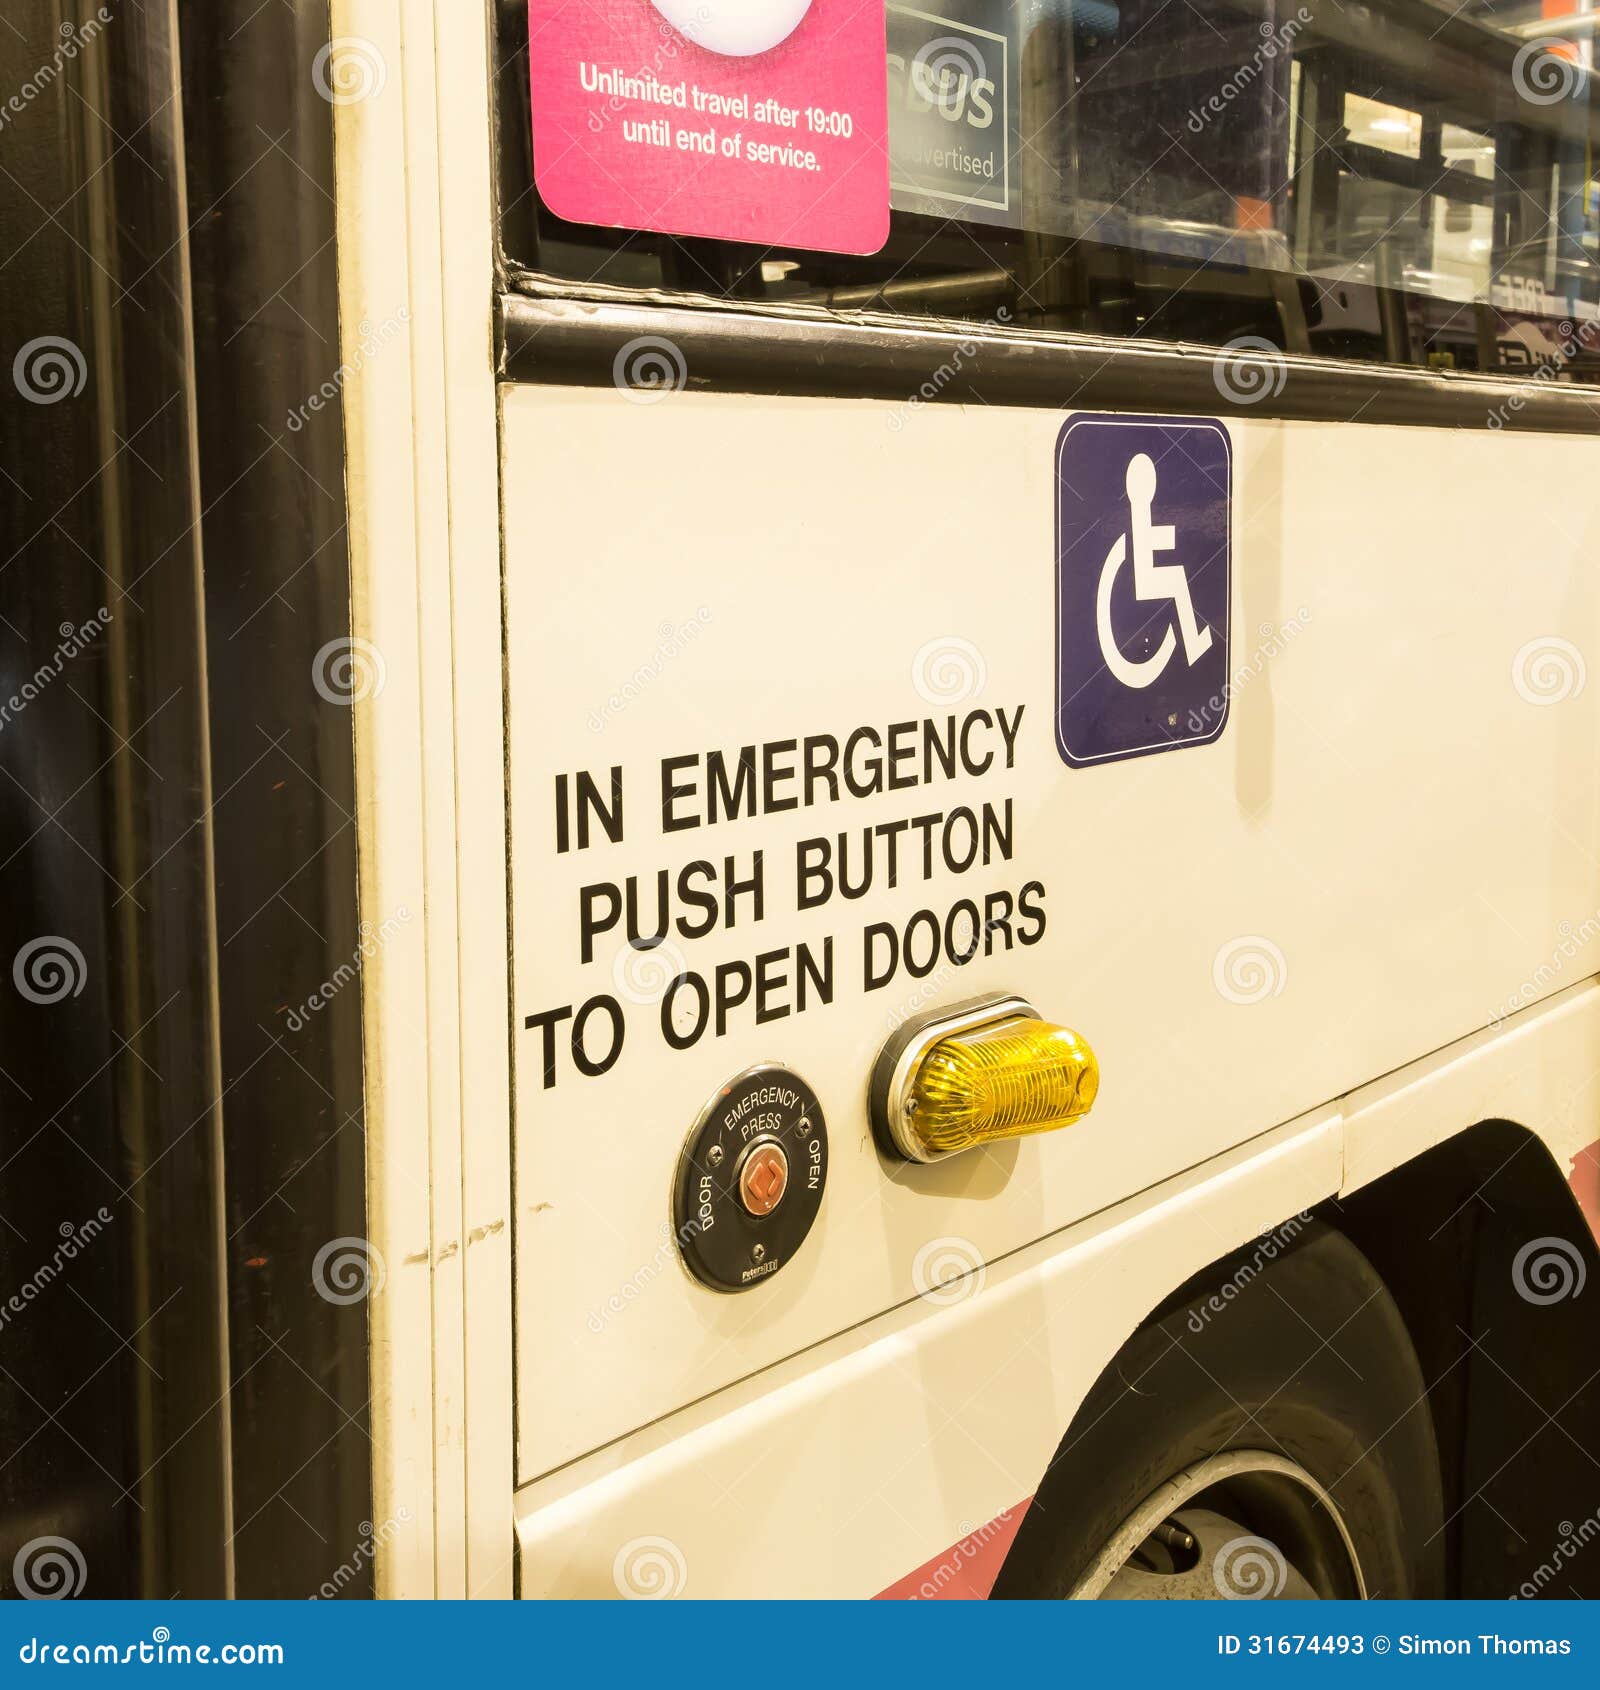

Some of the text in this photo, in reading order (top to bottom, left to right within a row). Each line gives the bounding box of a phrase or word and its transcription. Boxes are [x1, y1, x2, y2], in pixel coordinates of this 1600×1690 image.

[579, 62, 853, 138] Unlimited travel after 19:00
[623, 119, 822, 171] until end of service.
[555, 704, 1026, 854] IN EMERGENCY
[579, 798, 1014, 965] PUSH BUTTON
[524, 880, 1048, 1090] TO OPEN DOORS
[724, 1086, 800, 1132] EMERGENCY
[741, 1112, 782, 1142] PRESS
[807, 1139, 821, 1190] OPEN
[700, 1174, 716, 1232] DOOR
